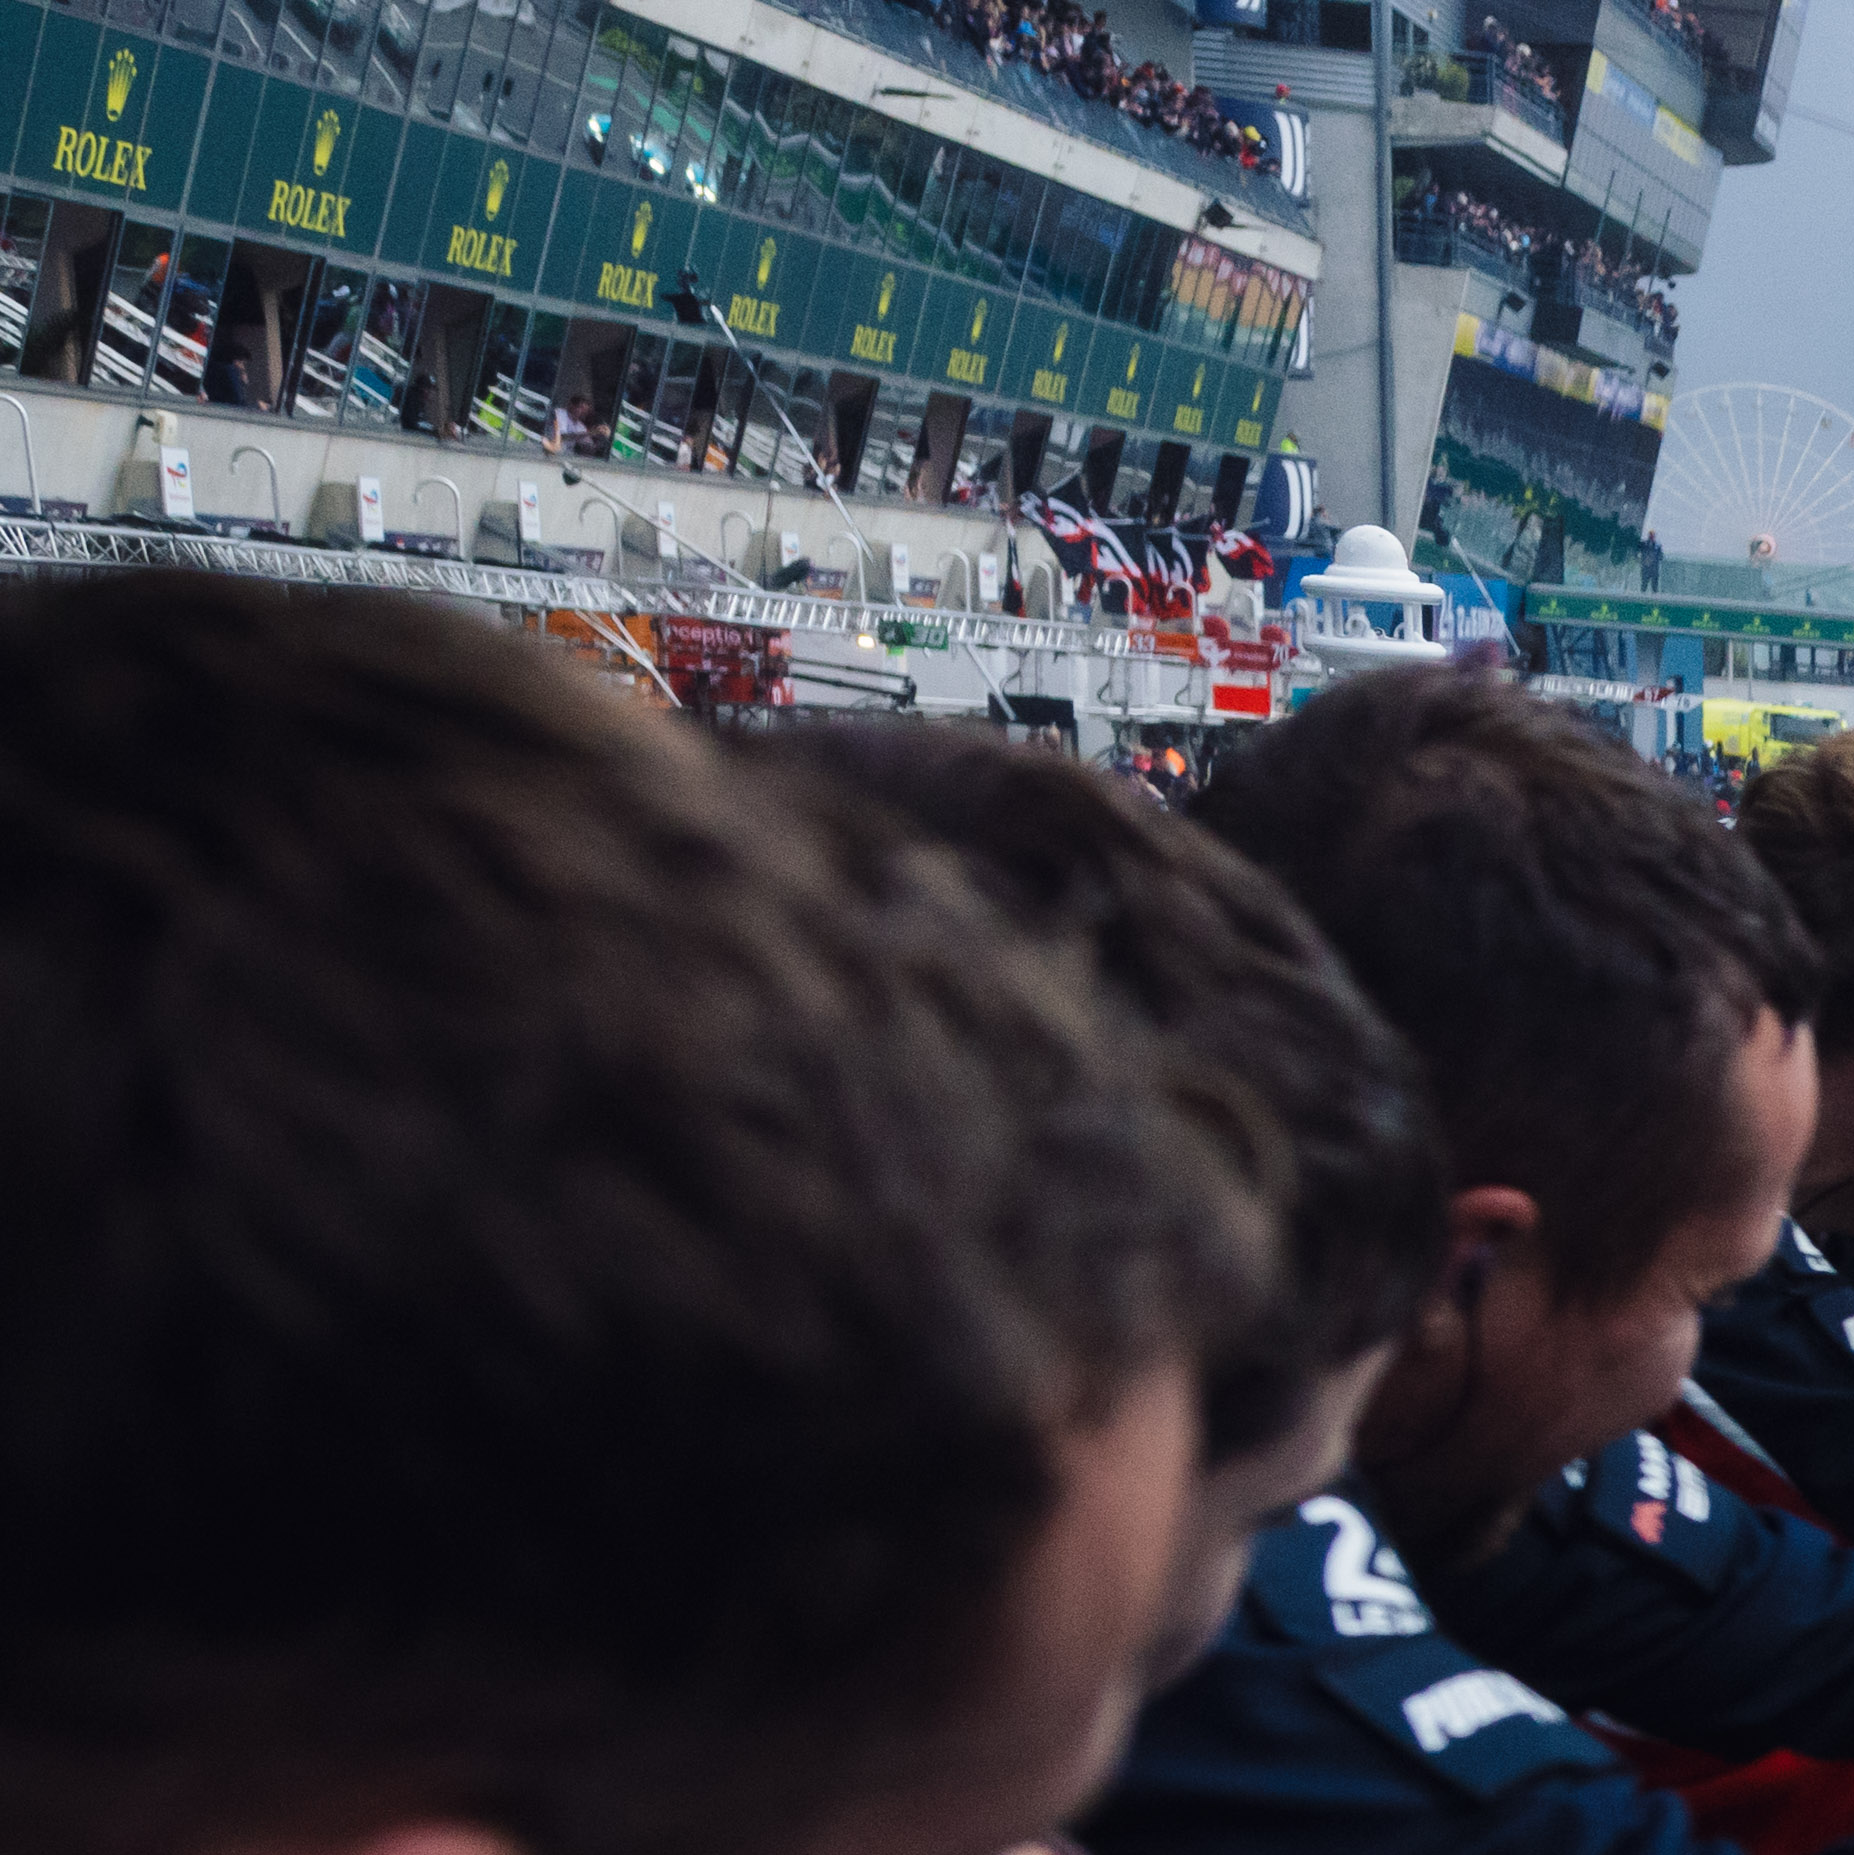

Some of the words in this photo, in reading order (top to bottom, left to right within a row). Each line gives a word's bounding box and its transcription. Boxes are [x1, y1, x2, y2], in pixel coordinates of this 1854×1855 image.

[52, 125, 153, 192] ROLEX
[267, 179, 352, 239] ROLEX
[446, 225, 518, 277] ROLEX
[598, 261, 658, 309] ROLEX
[727, 293, 781, 338] ROLEX
[850, 324, 897, 364] ROLEX
